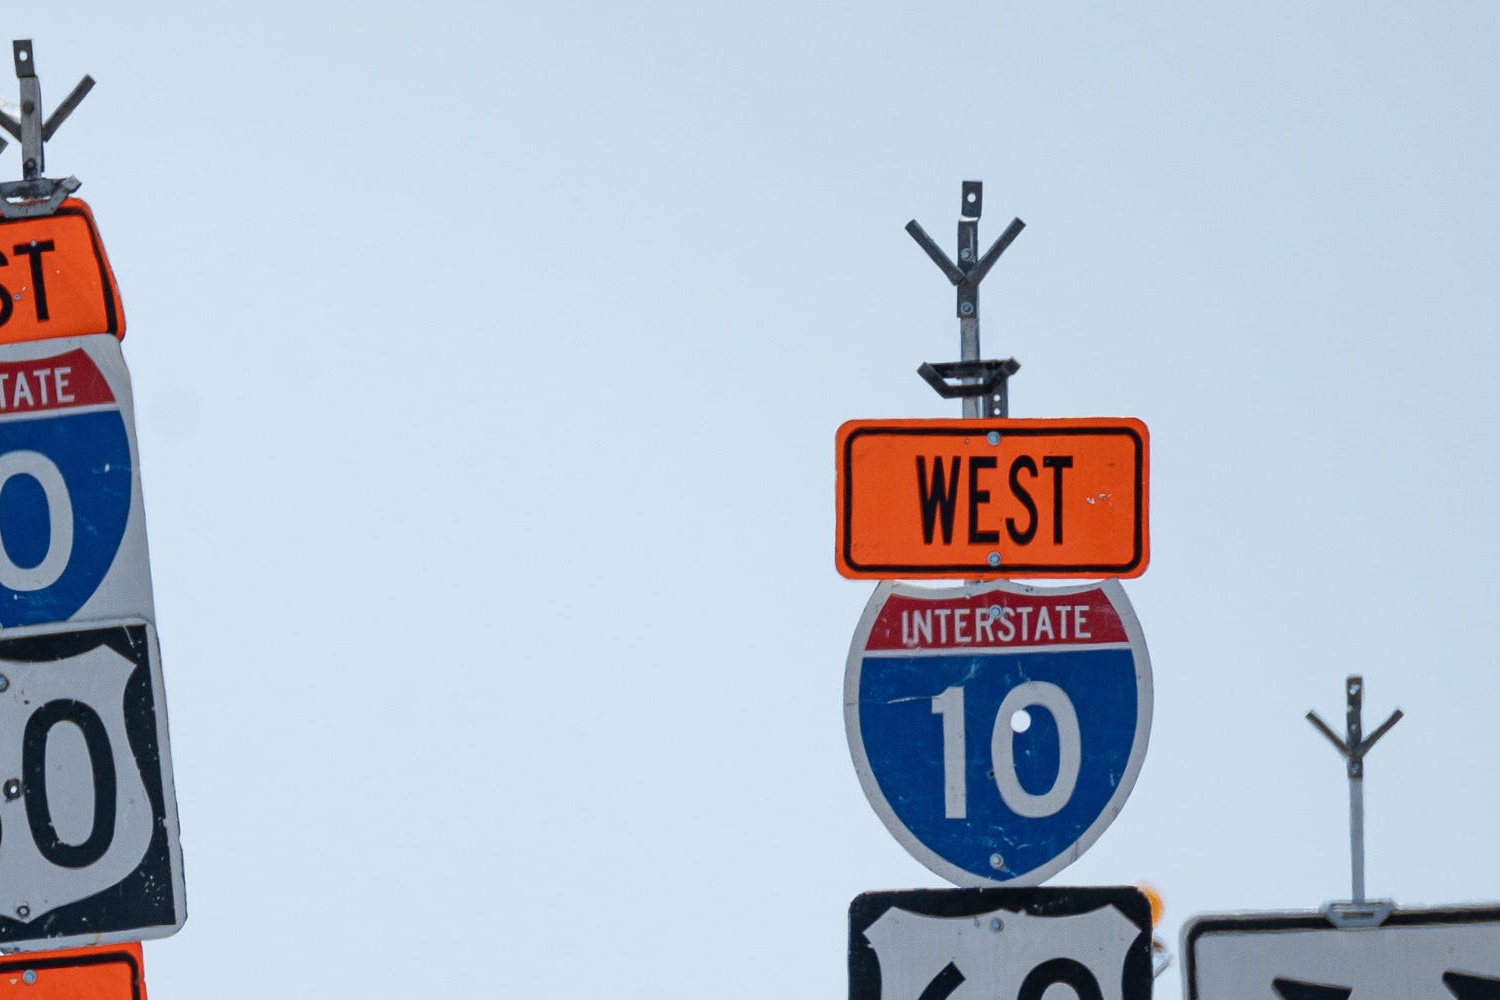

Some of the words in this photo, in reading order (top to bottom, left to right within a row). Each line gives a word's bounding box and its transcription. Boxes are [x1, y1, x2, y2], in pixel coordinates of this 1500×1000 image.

[916, 455, 1074, 546] WEST
[902, 605, 1092, 645] INTERSTATE
[931, 680, 1082, 819] 10
